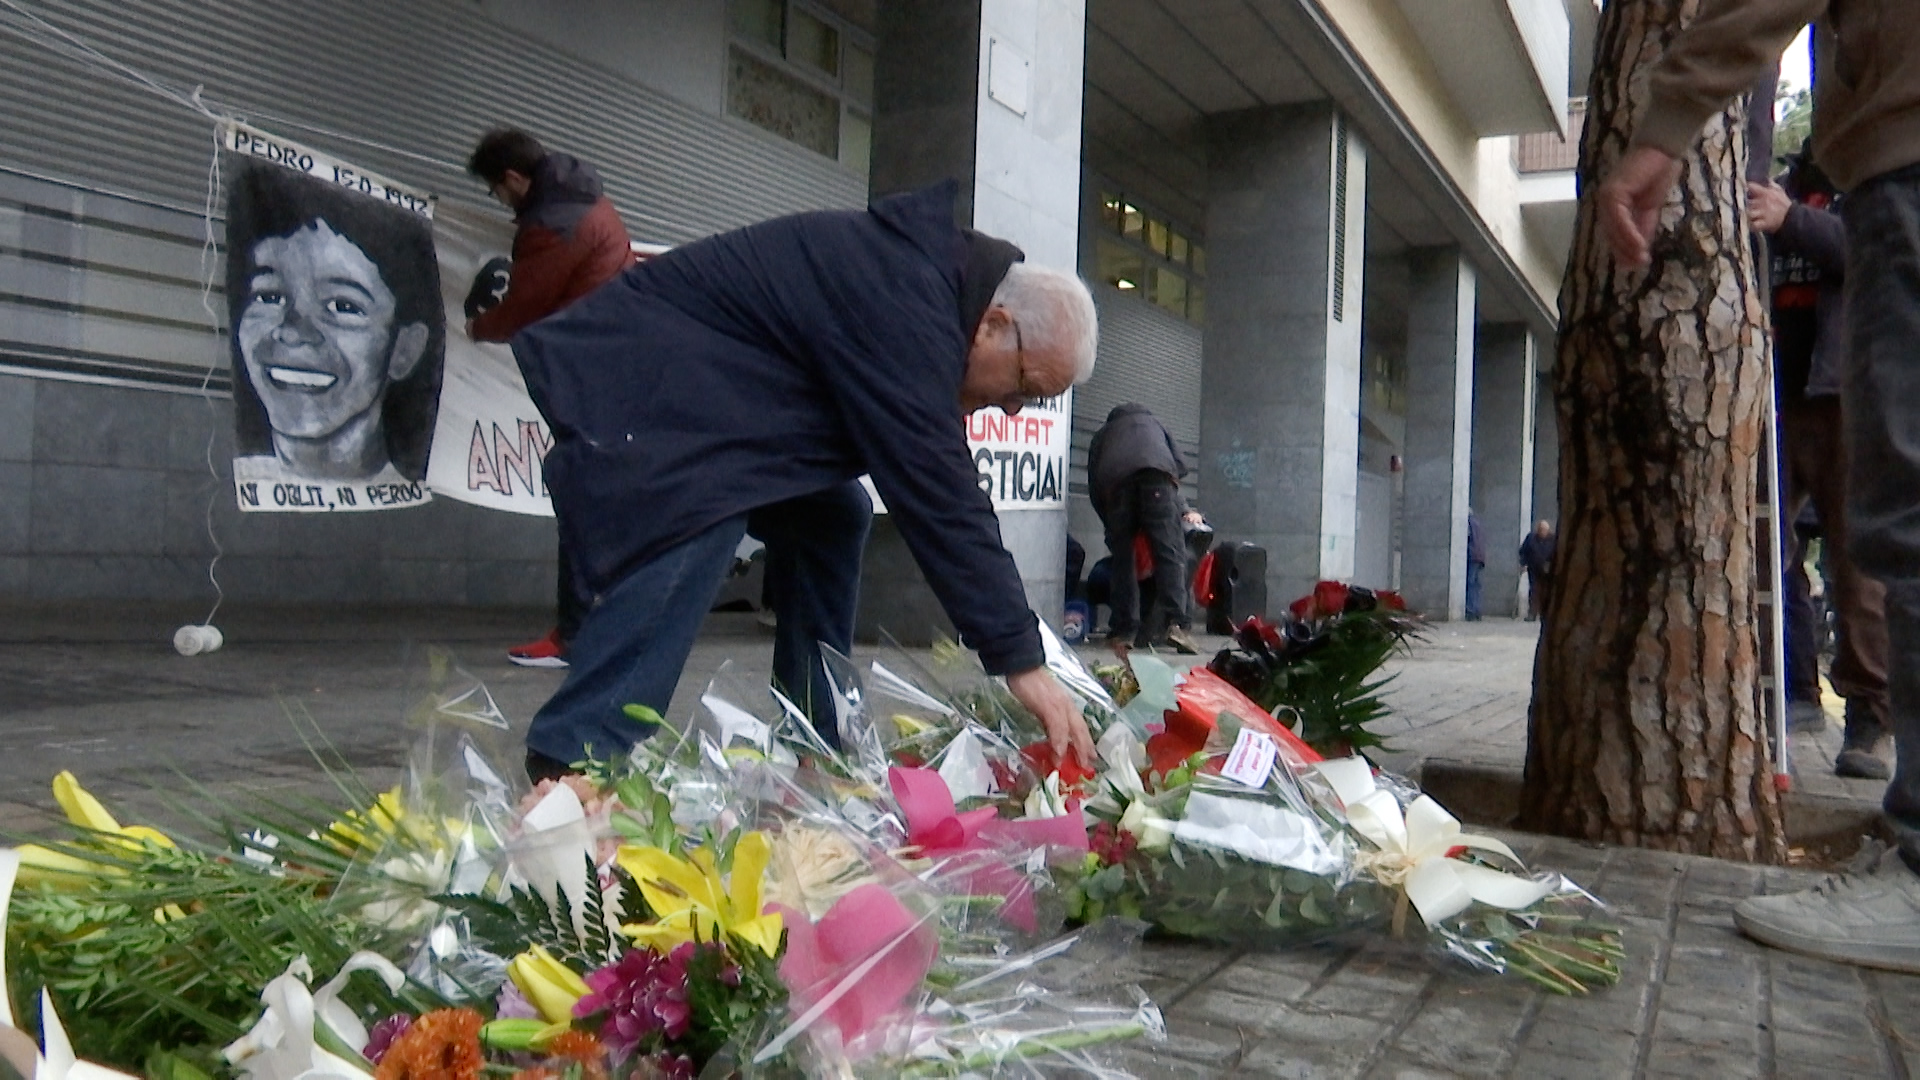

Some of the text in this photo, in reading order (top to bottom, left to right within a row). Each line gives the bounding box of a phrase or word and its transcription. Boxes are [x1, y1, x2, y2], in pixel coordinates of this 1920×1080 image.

[235, 131, 313, 172] PEDRO
[964, 414, 1054, 445] UNITAT
[240, 483, 259, 506] NI
[337, 487, 357, 506] NI
